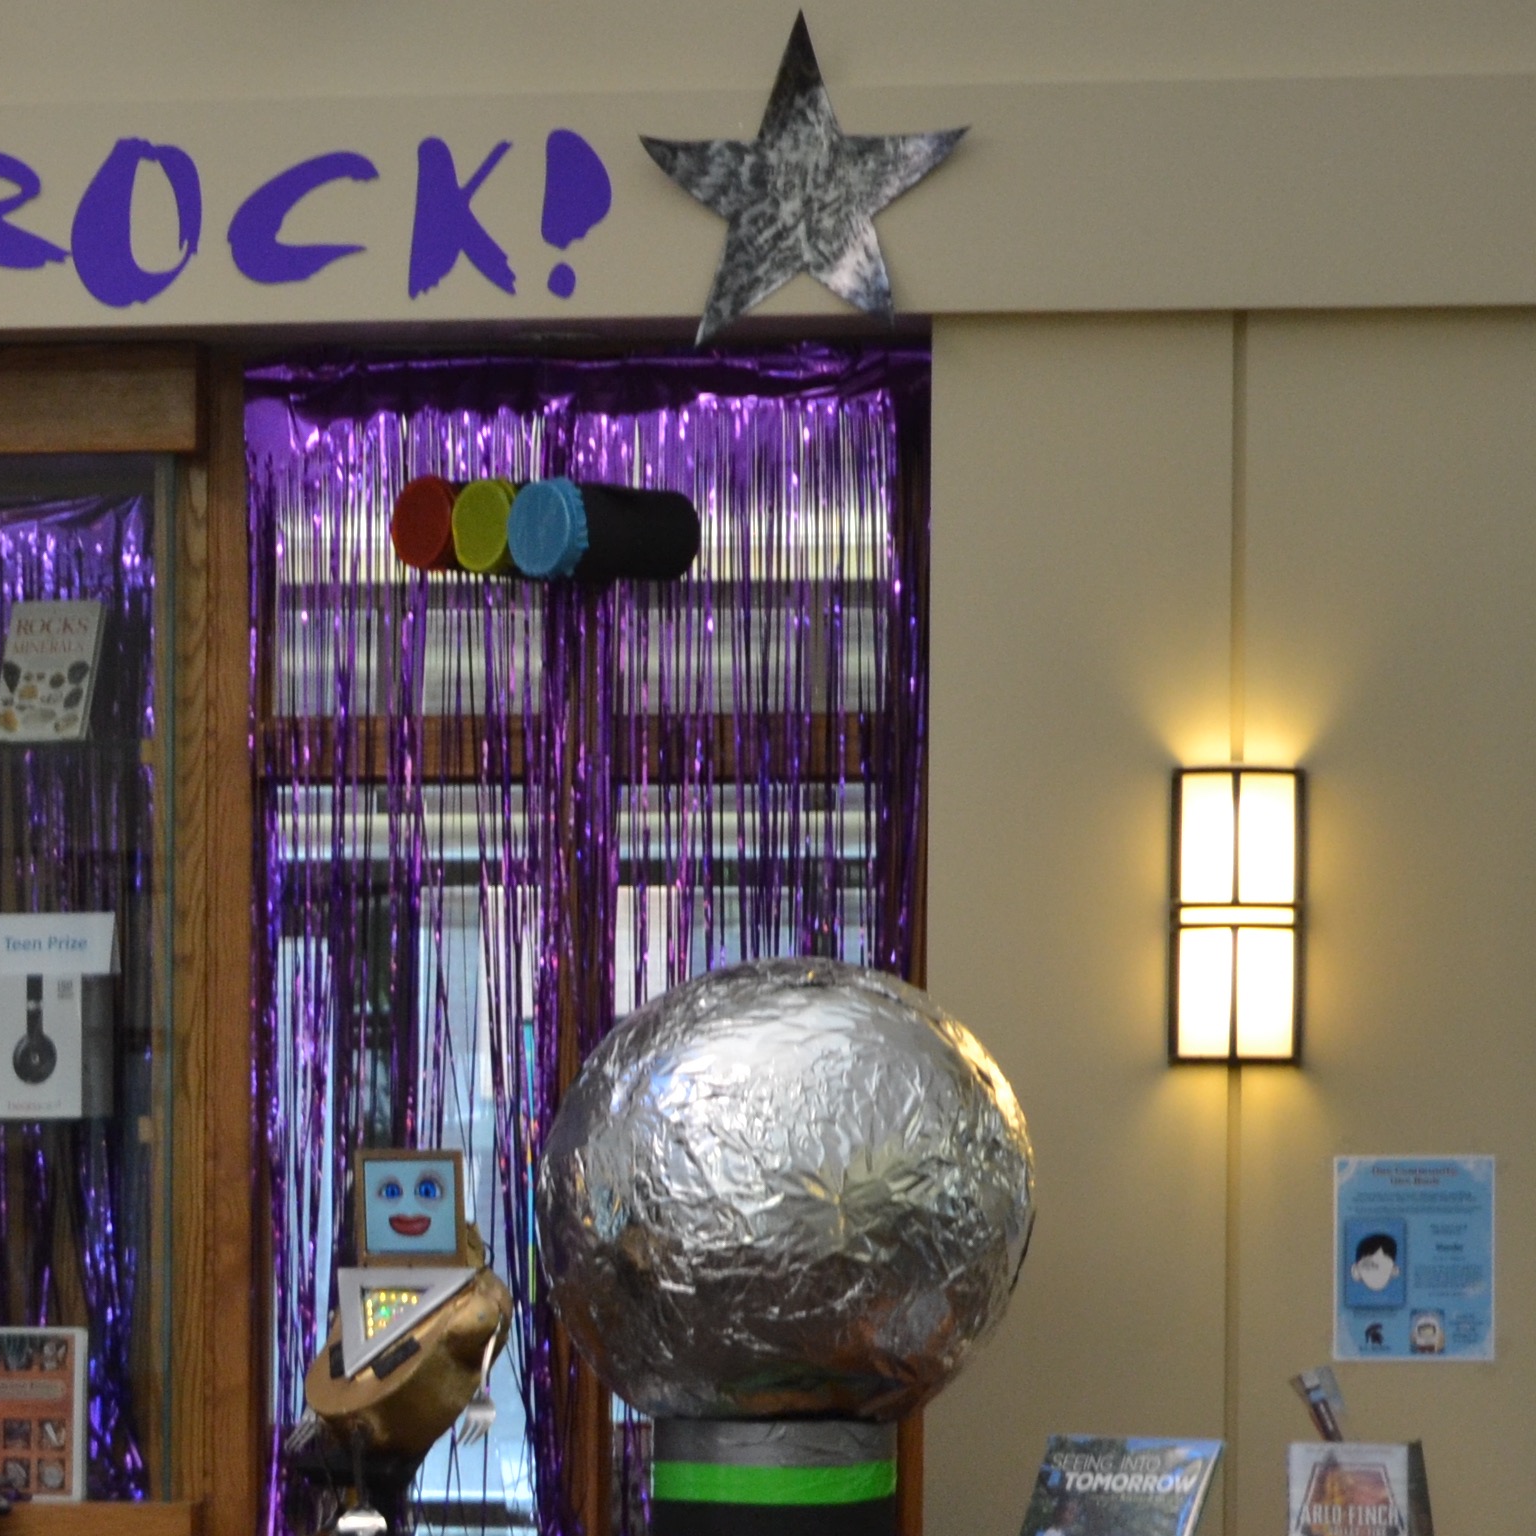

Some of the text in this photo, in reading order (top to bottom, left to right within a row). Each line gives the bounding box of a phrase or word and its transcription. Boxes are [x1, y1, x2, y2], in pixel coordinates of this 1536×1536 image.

[16, 617, 88, 635] ROCKS
[5, 935, 88, 951] Teen Prize
[1052, 1453, 1161, 1472] SEEING INTO
[1065, 1472, 1198, 1494] TOMORROW
[1348, 1504, 1399, 1525] FINCH
